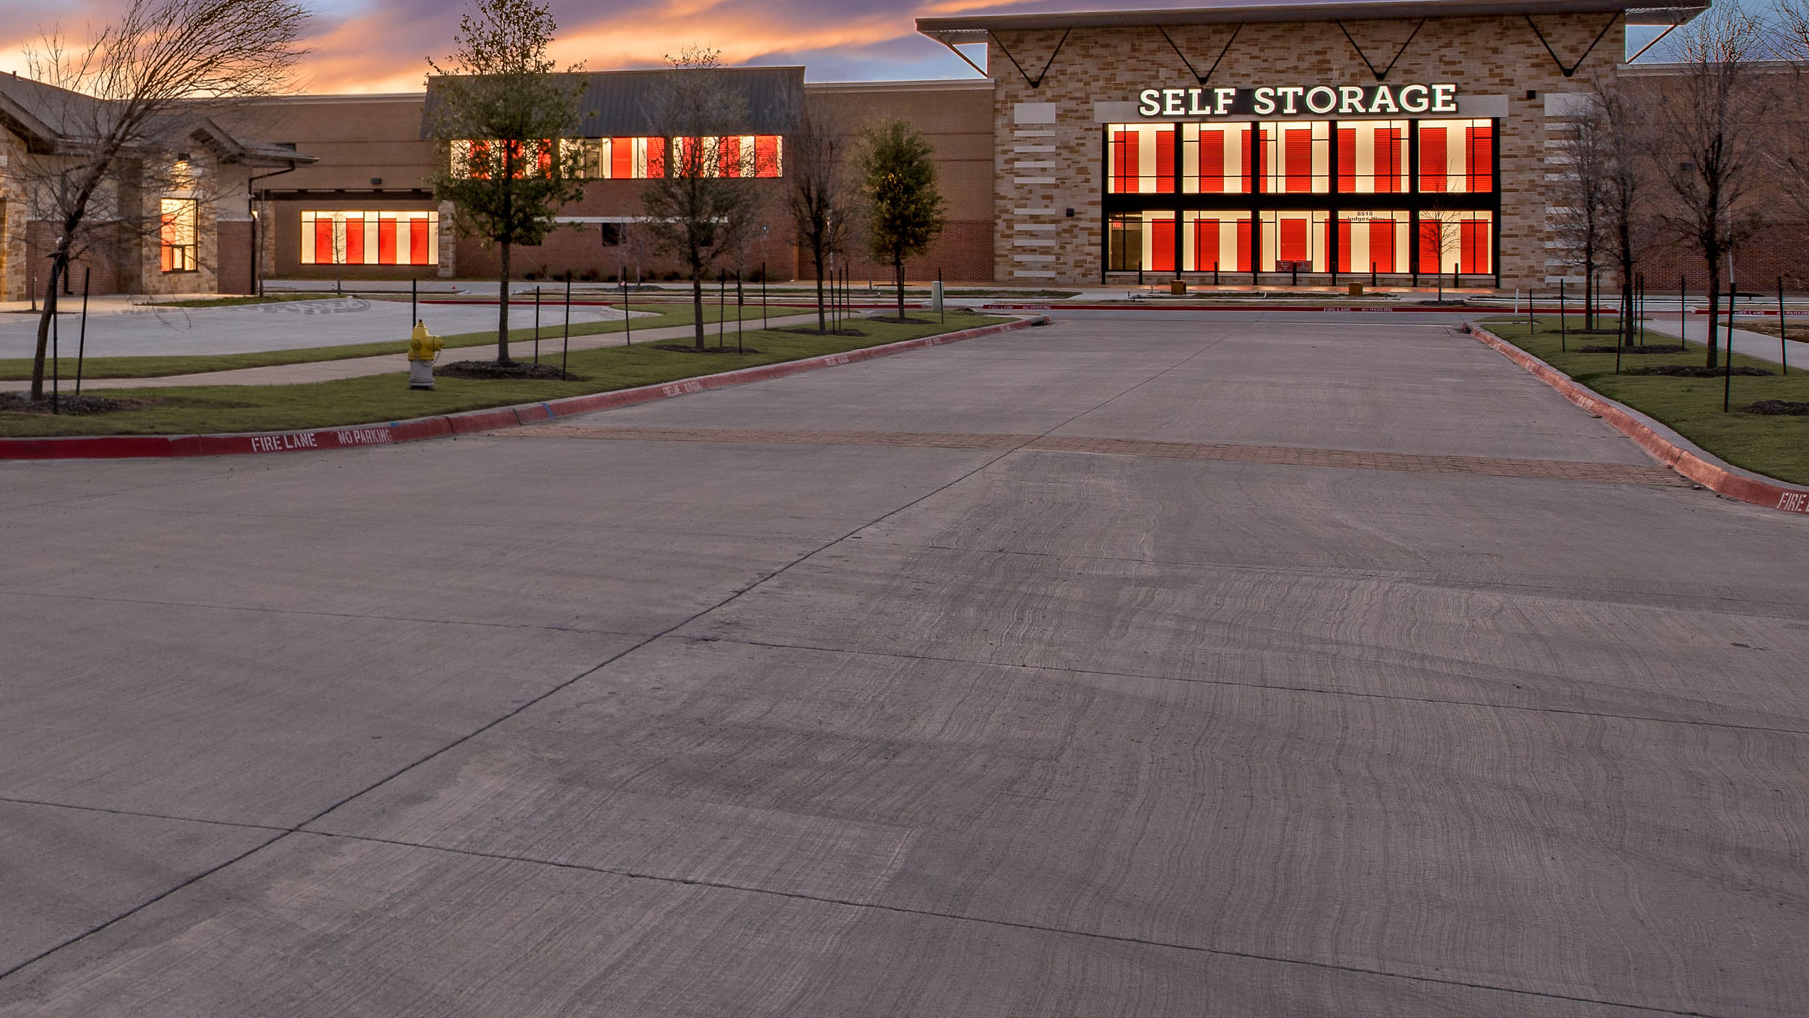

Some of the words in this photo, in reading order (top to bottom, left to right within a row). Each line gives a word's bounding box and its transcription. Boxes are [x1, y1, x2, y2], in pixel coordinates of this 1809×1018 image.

[1139, 87, 1236, 116] SELF
[1253, 84, 1457, 115] STORAGE
[251, 436, 283, 452] FIRE
[283, 433, 318, 449] LANE
[337, 430, 353, 445] NO
[353, 428, 392, 443] PARKING
[1775, 492, 1807, 512] FIRE
